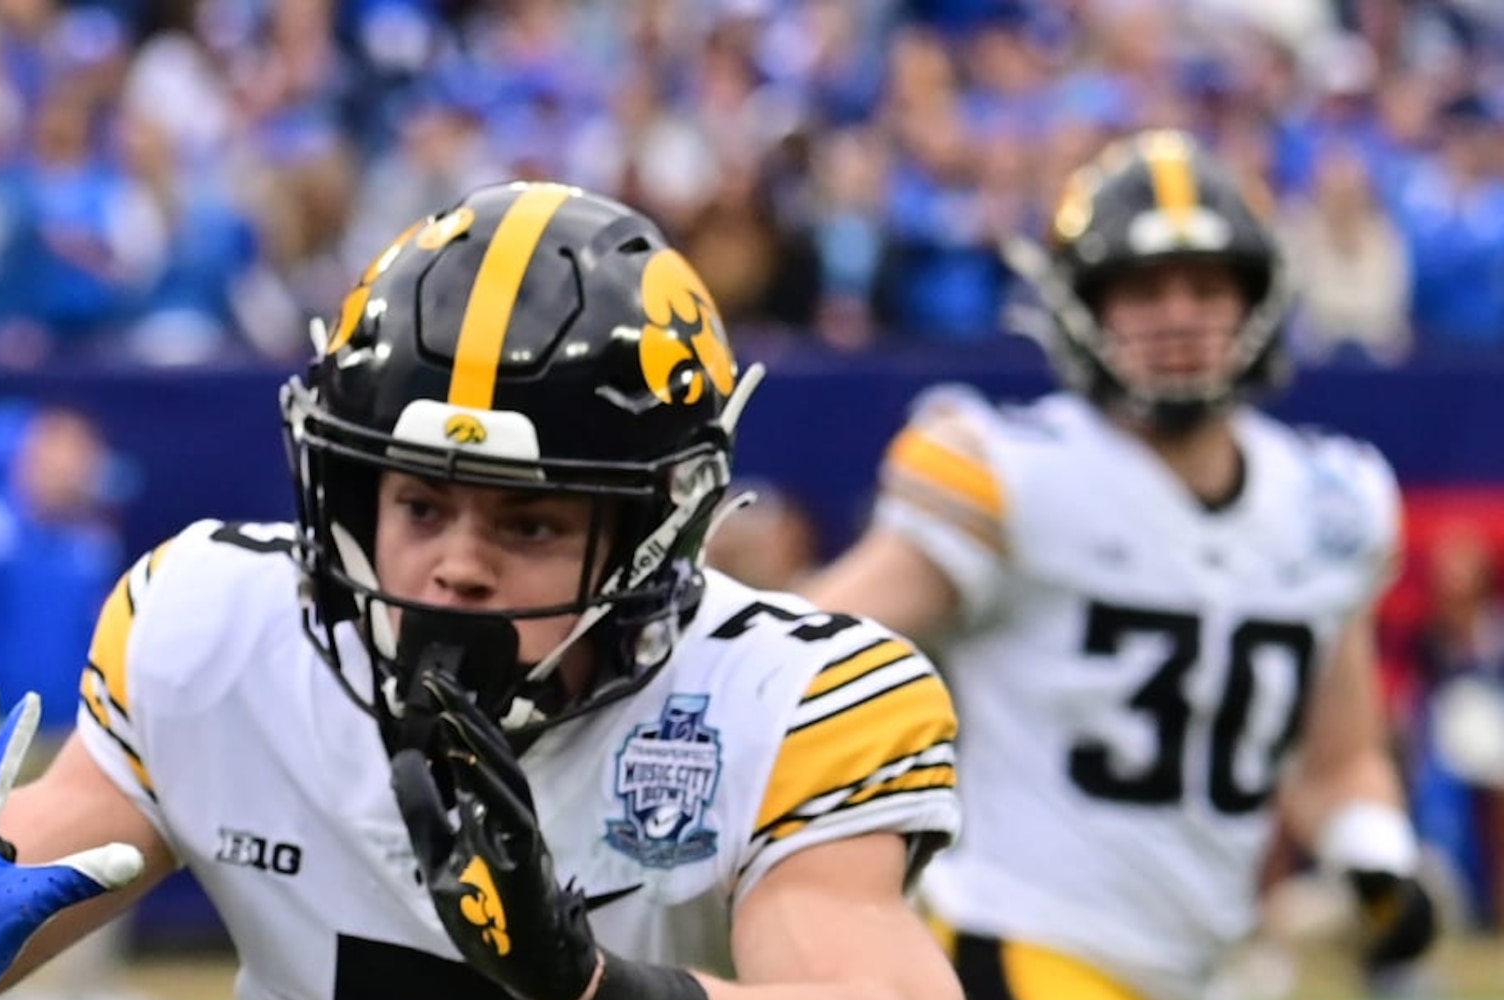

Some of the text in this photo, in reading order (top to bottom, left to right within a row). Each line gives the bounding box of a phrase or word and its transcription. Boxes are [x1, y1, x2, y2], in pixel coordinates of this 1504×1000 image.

[1069, 600, 1315, 815] 30
[624, 761, 713, 793] MUSIC CITY
